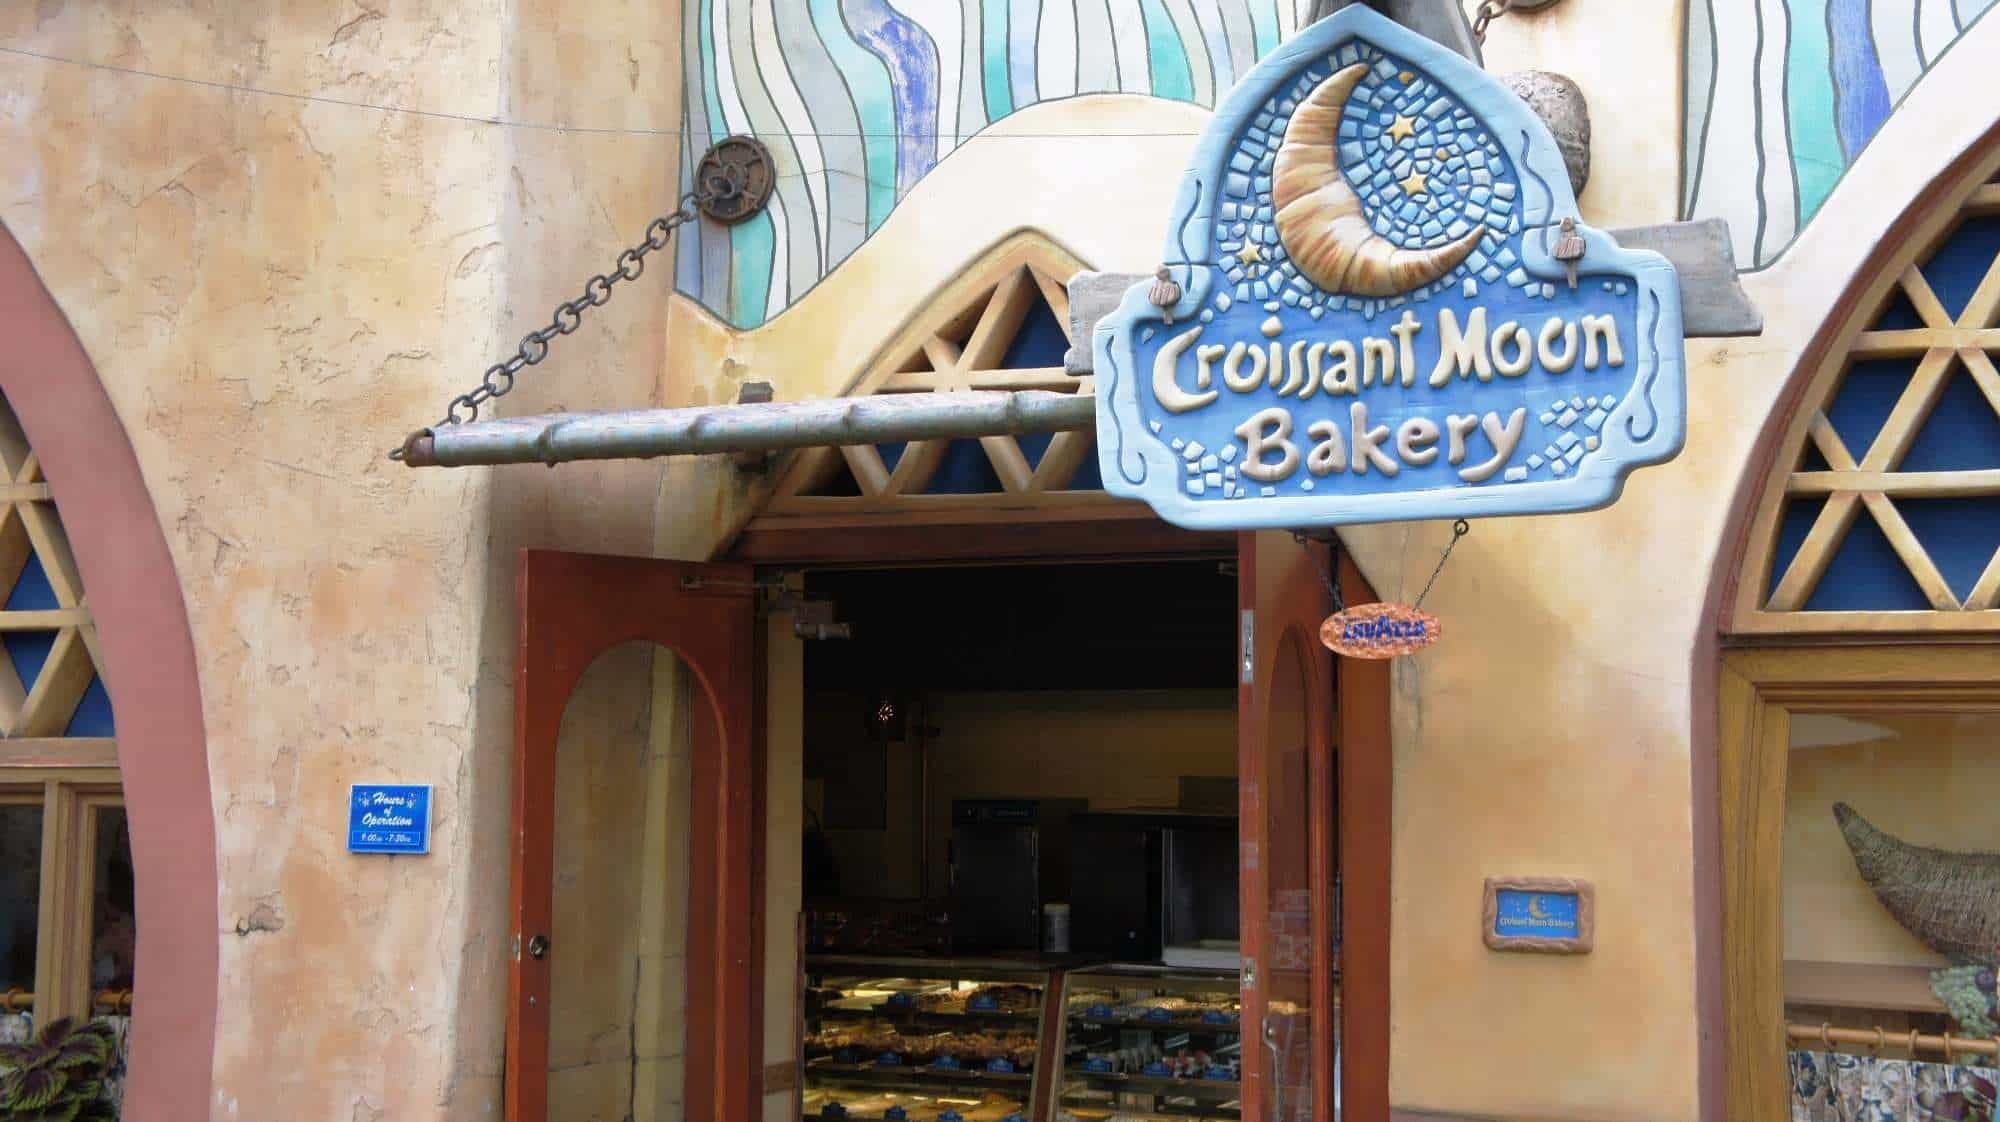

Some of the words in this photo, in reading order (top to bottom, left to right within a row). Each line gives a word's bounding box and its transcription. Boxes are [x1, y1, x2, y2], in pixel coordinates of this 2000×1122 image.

[1152, 309, 1421, 413] Croissant
[1429, 306, 1624, 386] Moon
[1234, 401, 1527, 482] Bakery
[361, 812, 413, 828] Operation
[372, 792, 405, 806] Hours
